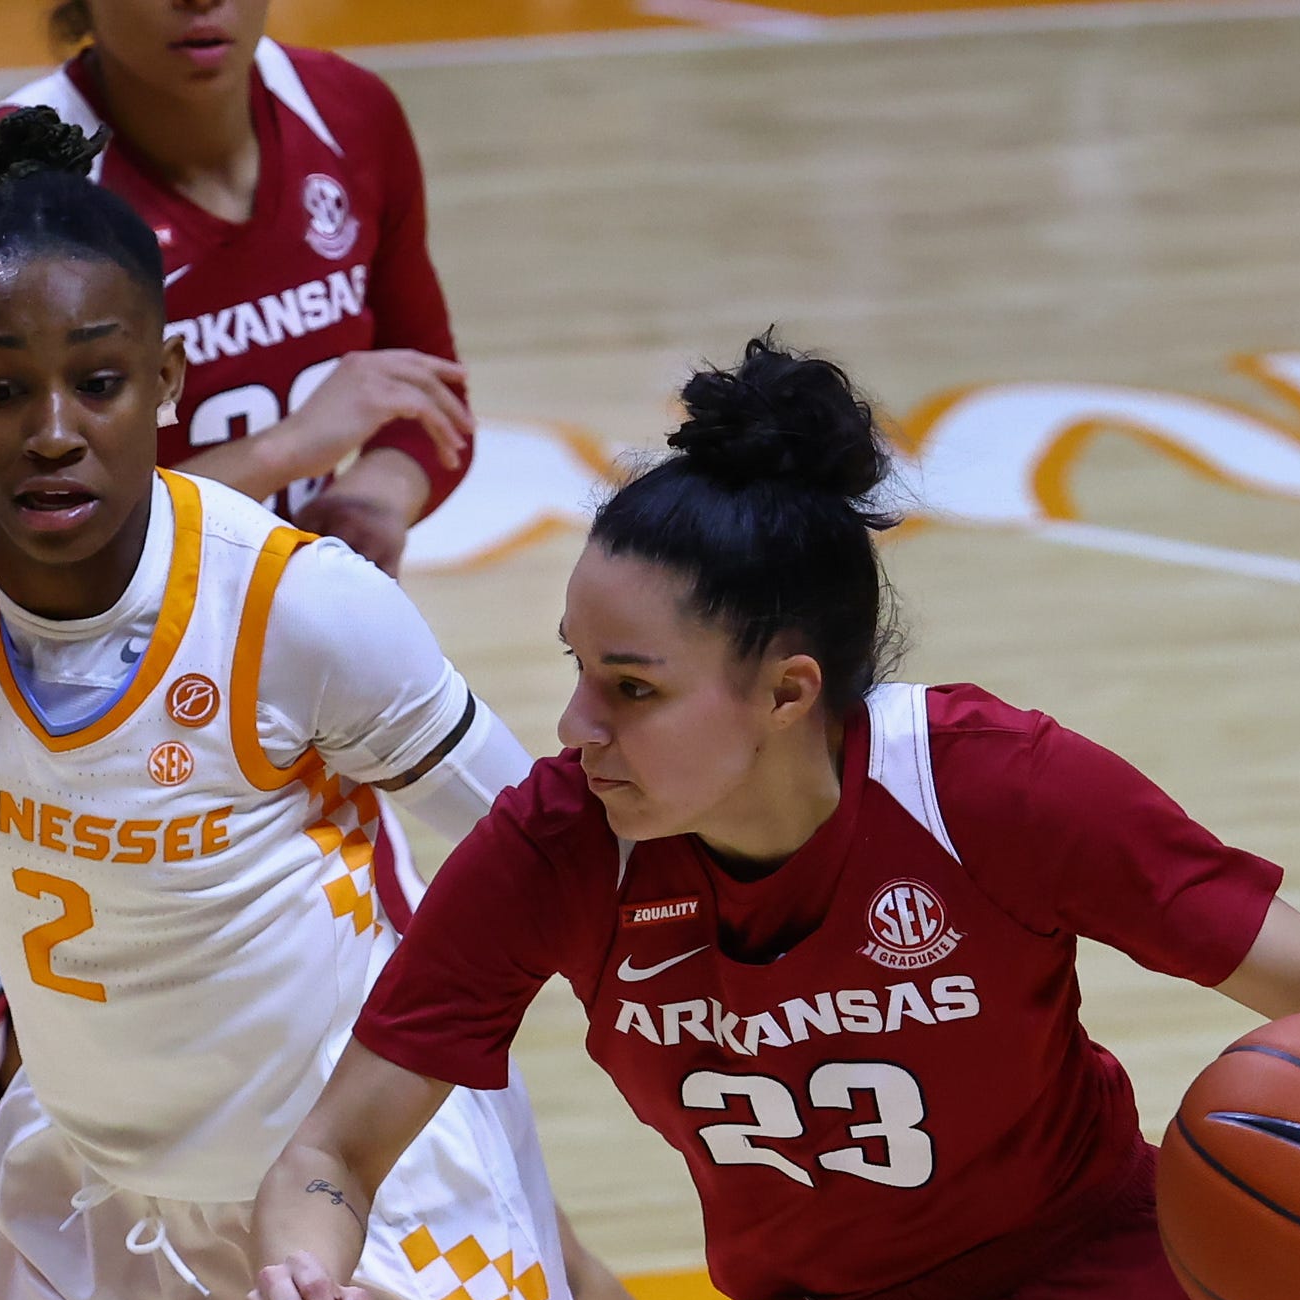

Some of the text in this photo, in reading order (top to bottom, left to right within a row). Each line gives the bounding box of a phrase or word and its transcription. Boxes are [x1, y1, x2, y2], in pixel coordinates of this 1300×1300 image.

[152, 746, 189, 783] SEC
[12, 867, 107, 1002] 2
[633, 901, 698, 922] EQUALITY
[875, 887, 938, 945] SEC
[879, 941, 950, 967] GRADUATE
[614, 975, 981, 1056] ARKANSAS
[681, 1062, 934, 1189] 23
